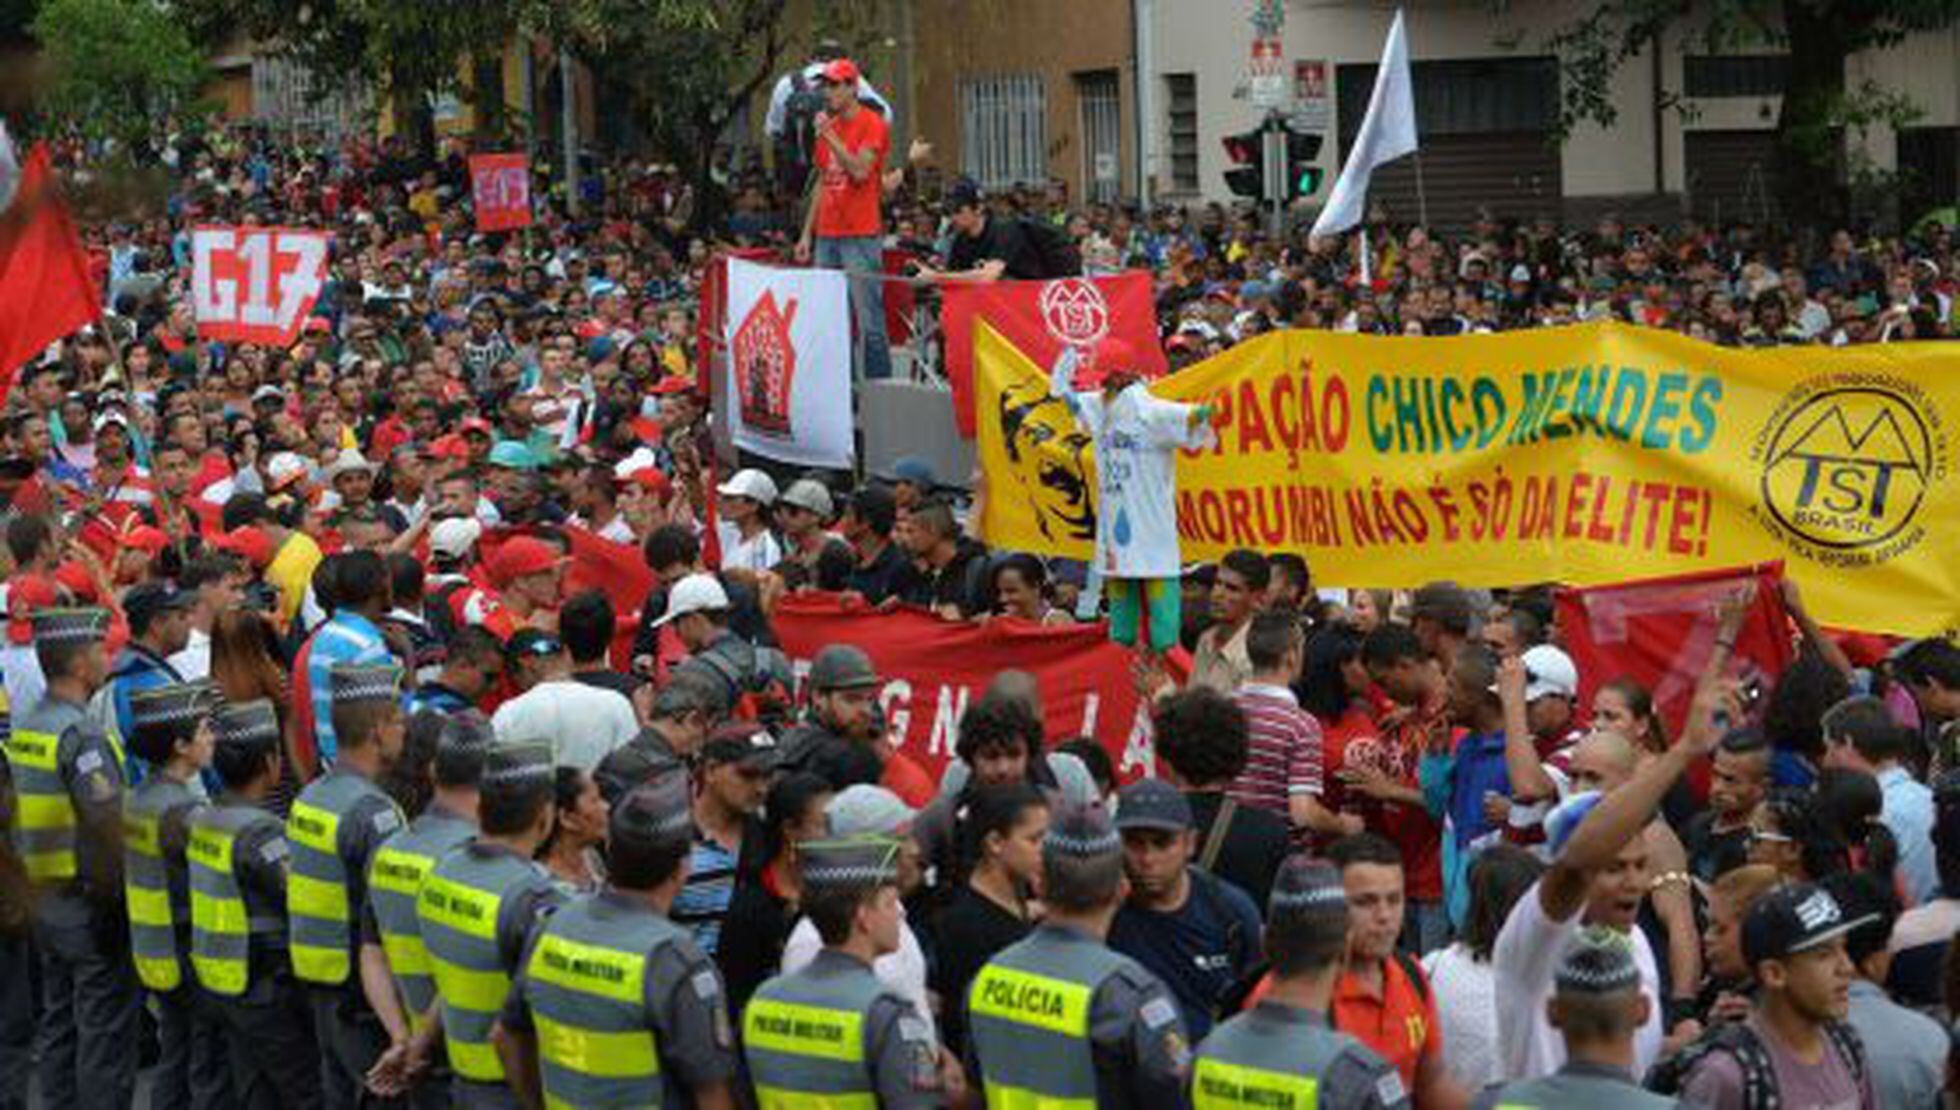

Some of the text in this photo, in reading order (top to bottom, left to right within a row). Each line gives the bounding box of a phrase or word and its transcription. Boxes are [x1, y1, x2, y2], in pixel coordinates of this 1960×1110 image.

[193, 230, 328, 334] G17
[1366, 372, 1508, 454] CHICO
[1506, 363, 1723, 454] MENDES
[1176, 484, 1341, 548] MORUMBI
[1347, 475, 1428, 548] NÃO
[1428, 473, 1460, 542] É
[1467, 465, 1513, 542] SÓ
[1518, 475, 1557, 541] DA
[1563, 472, 1712, 558] ELITE!
[1793, 508, 1876, 535] BRASIL
